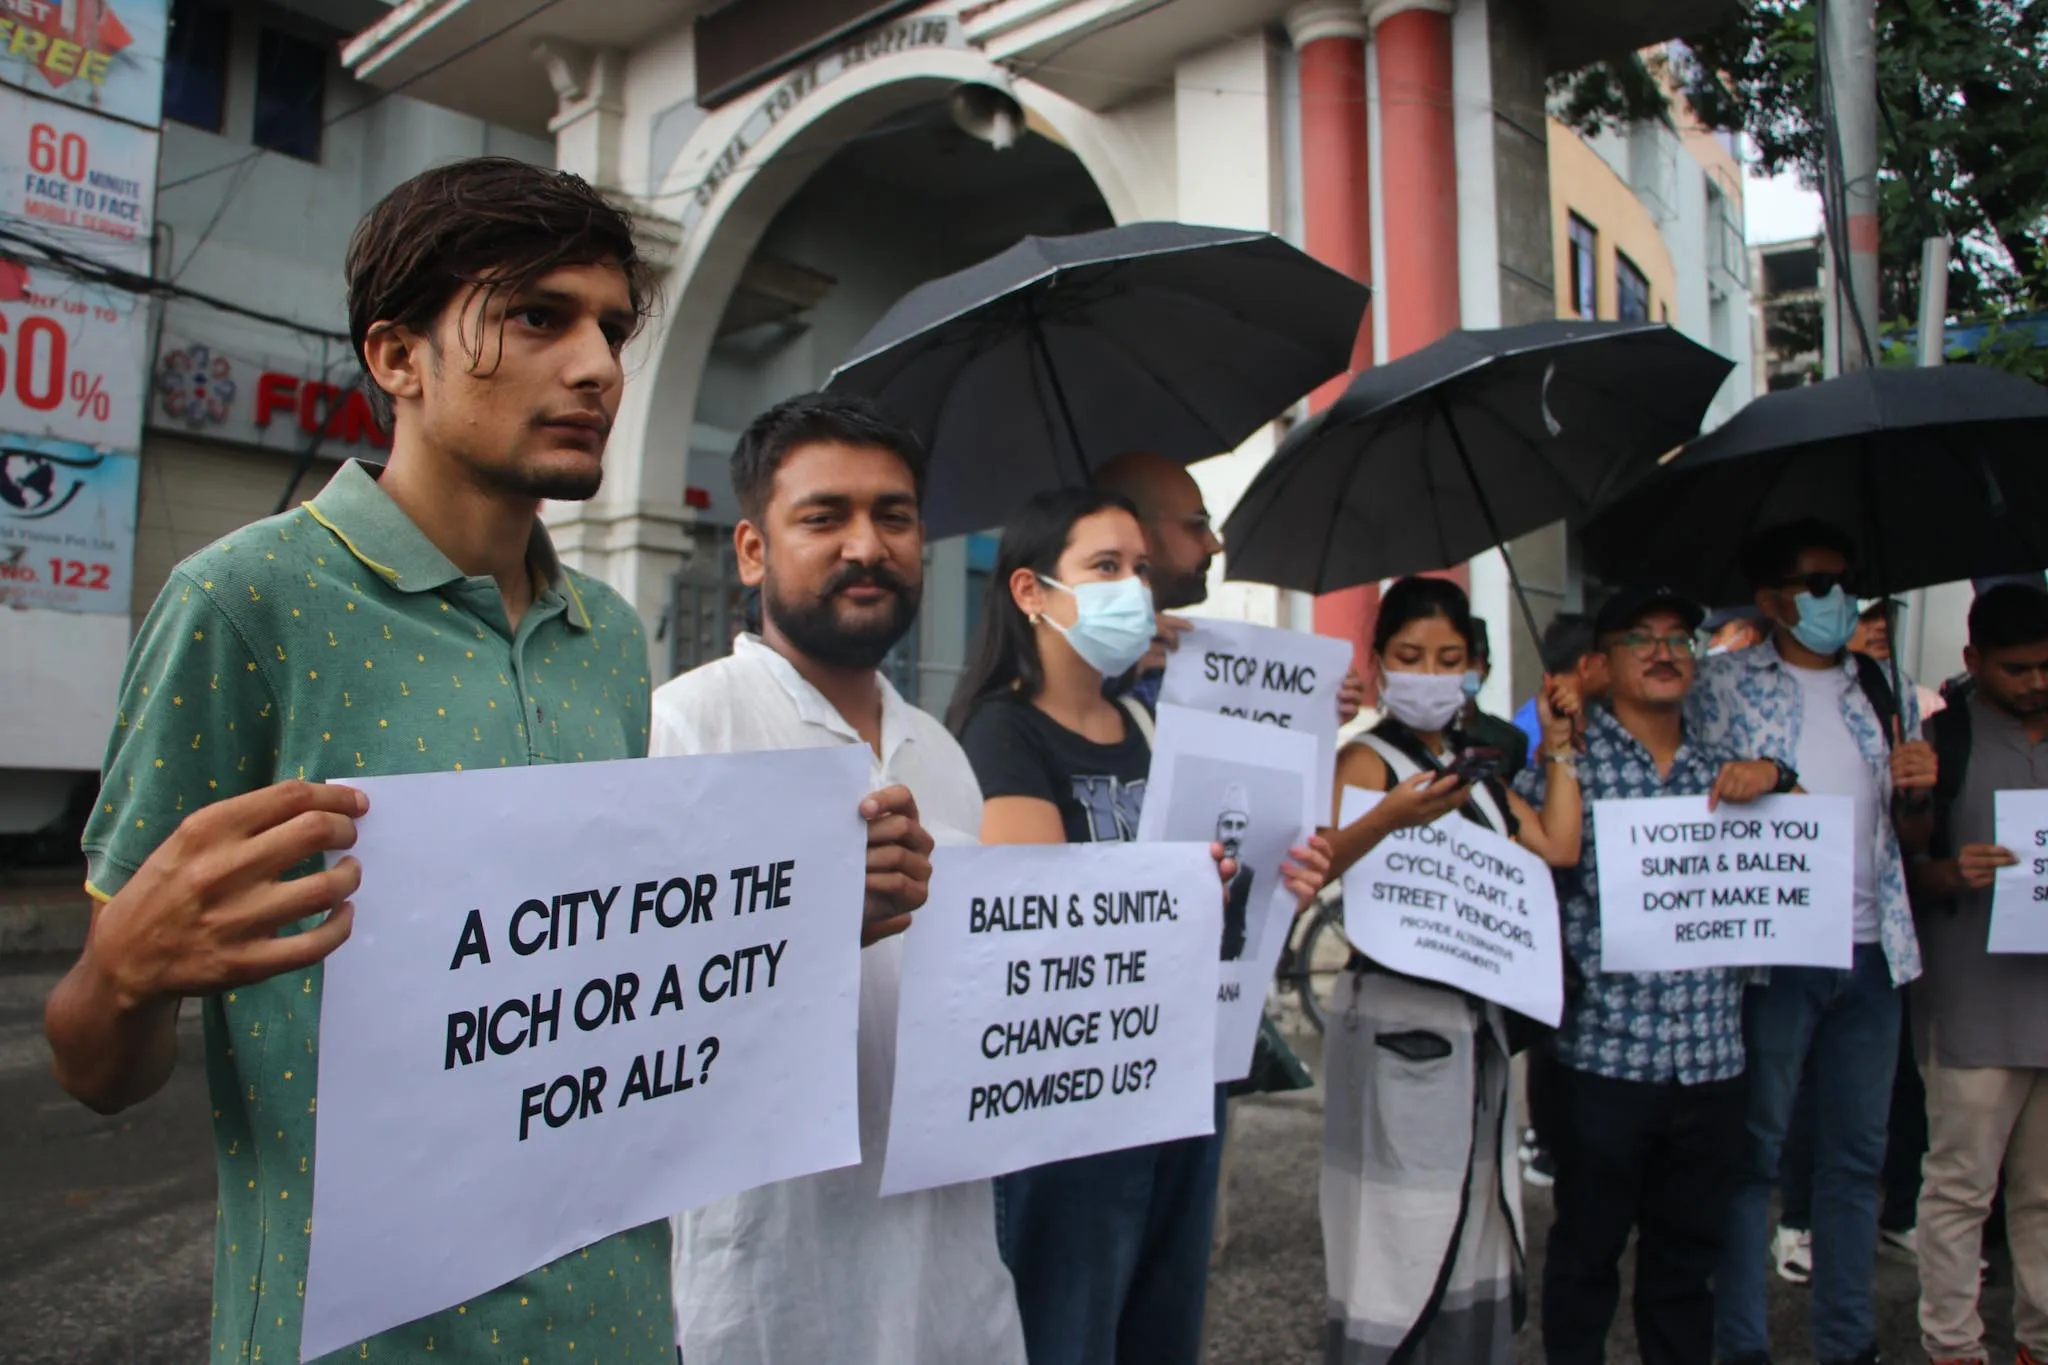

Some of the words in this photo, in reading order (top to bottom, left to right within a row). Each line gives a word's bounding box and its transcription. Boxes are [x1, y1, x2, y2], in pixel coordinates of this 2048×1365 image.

[29, 122, 87, 182] 60
[88, 169, 141, 199] MINUTE
[26, 173, 69, 203] FACE
[74, 187, 96, 210] TO
[99, 195, 139, 222] FACE
[0, 310, 111, 422] 0%
[48, 556, 111, 590] 122
[1204, 651, 1258, 686] STOP
[1261, 661, 1316, 695] KMC
[1392, 825, 1448, 847] STOP
[1449, 837, 1524, 884] LOOTING
[1630, 825, 1637, 845] I
[1643, 822, 1717, 843] VOTED
[1720, 819, 1762, 839] FOR
[1770, 821, 1819, 841] YOU
[2034, 829, 2048, 847] S
[1642, 855, 1710, 877] SUNITA
[1716, 853, 1729, 873] &
[1736, 853, 1810, 872] BALEN.
[2033, 858, 2048, 875] S
[449, 909, 491, 971] A
[508, 885, 622, 956] CITY
[629, 873, 718, 935] FOR
[730, 859, 795, 917] THE
[969, 894, 1058, 934] BALEN
[1066, 893, 1084, 928] &
[1093, 889, 1178, 927] SUNITA:
[1371, 882, 1449, 912] STREET
[1711, 886, 1769, 906] MAKE
[1777, 887, 1809, 906] ME
[2032, 885, 2048, 902] S
[1675, 919, 1747, 942] REGRET
[1754, 918, 1775, 938] IT.
[1006, 960, 1031, 997] IS
[1040, 955, 1096, 993] THIS
[1104, 950, 1147, 986] THE
[444, 988, 563, 1071] RICH
[573, 972, 640, 1032] OR
[650, 963, 684, 1017] A
[698, 939, 788, 1003] CITY
[981, 1011, 1102, 1060] CHANGE
[1110, 1004, 1159, 1041] YOU
[518, 1065, 608, 1142] FOR
[617, 1036, 720, 1108] ALL?
[968, 1067, 1104, 1122] PROMISED
[1111, 1058, 1157, 1095] US?
